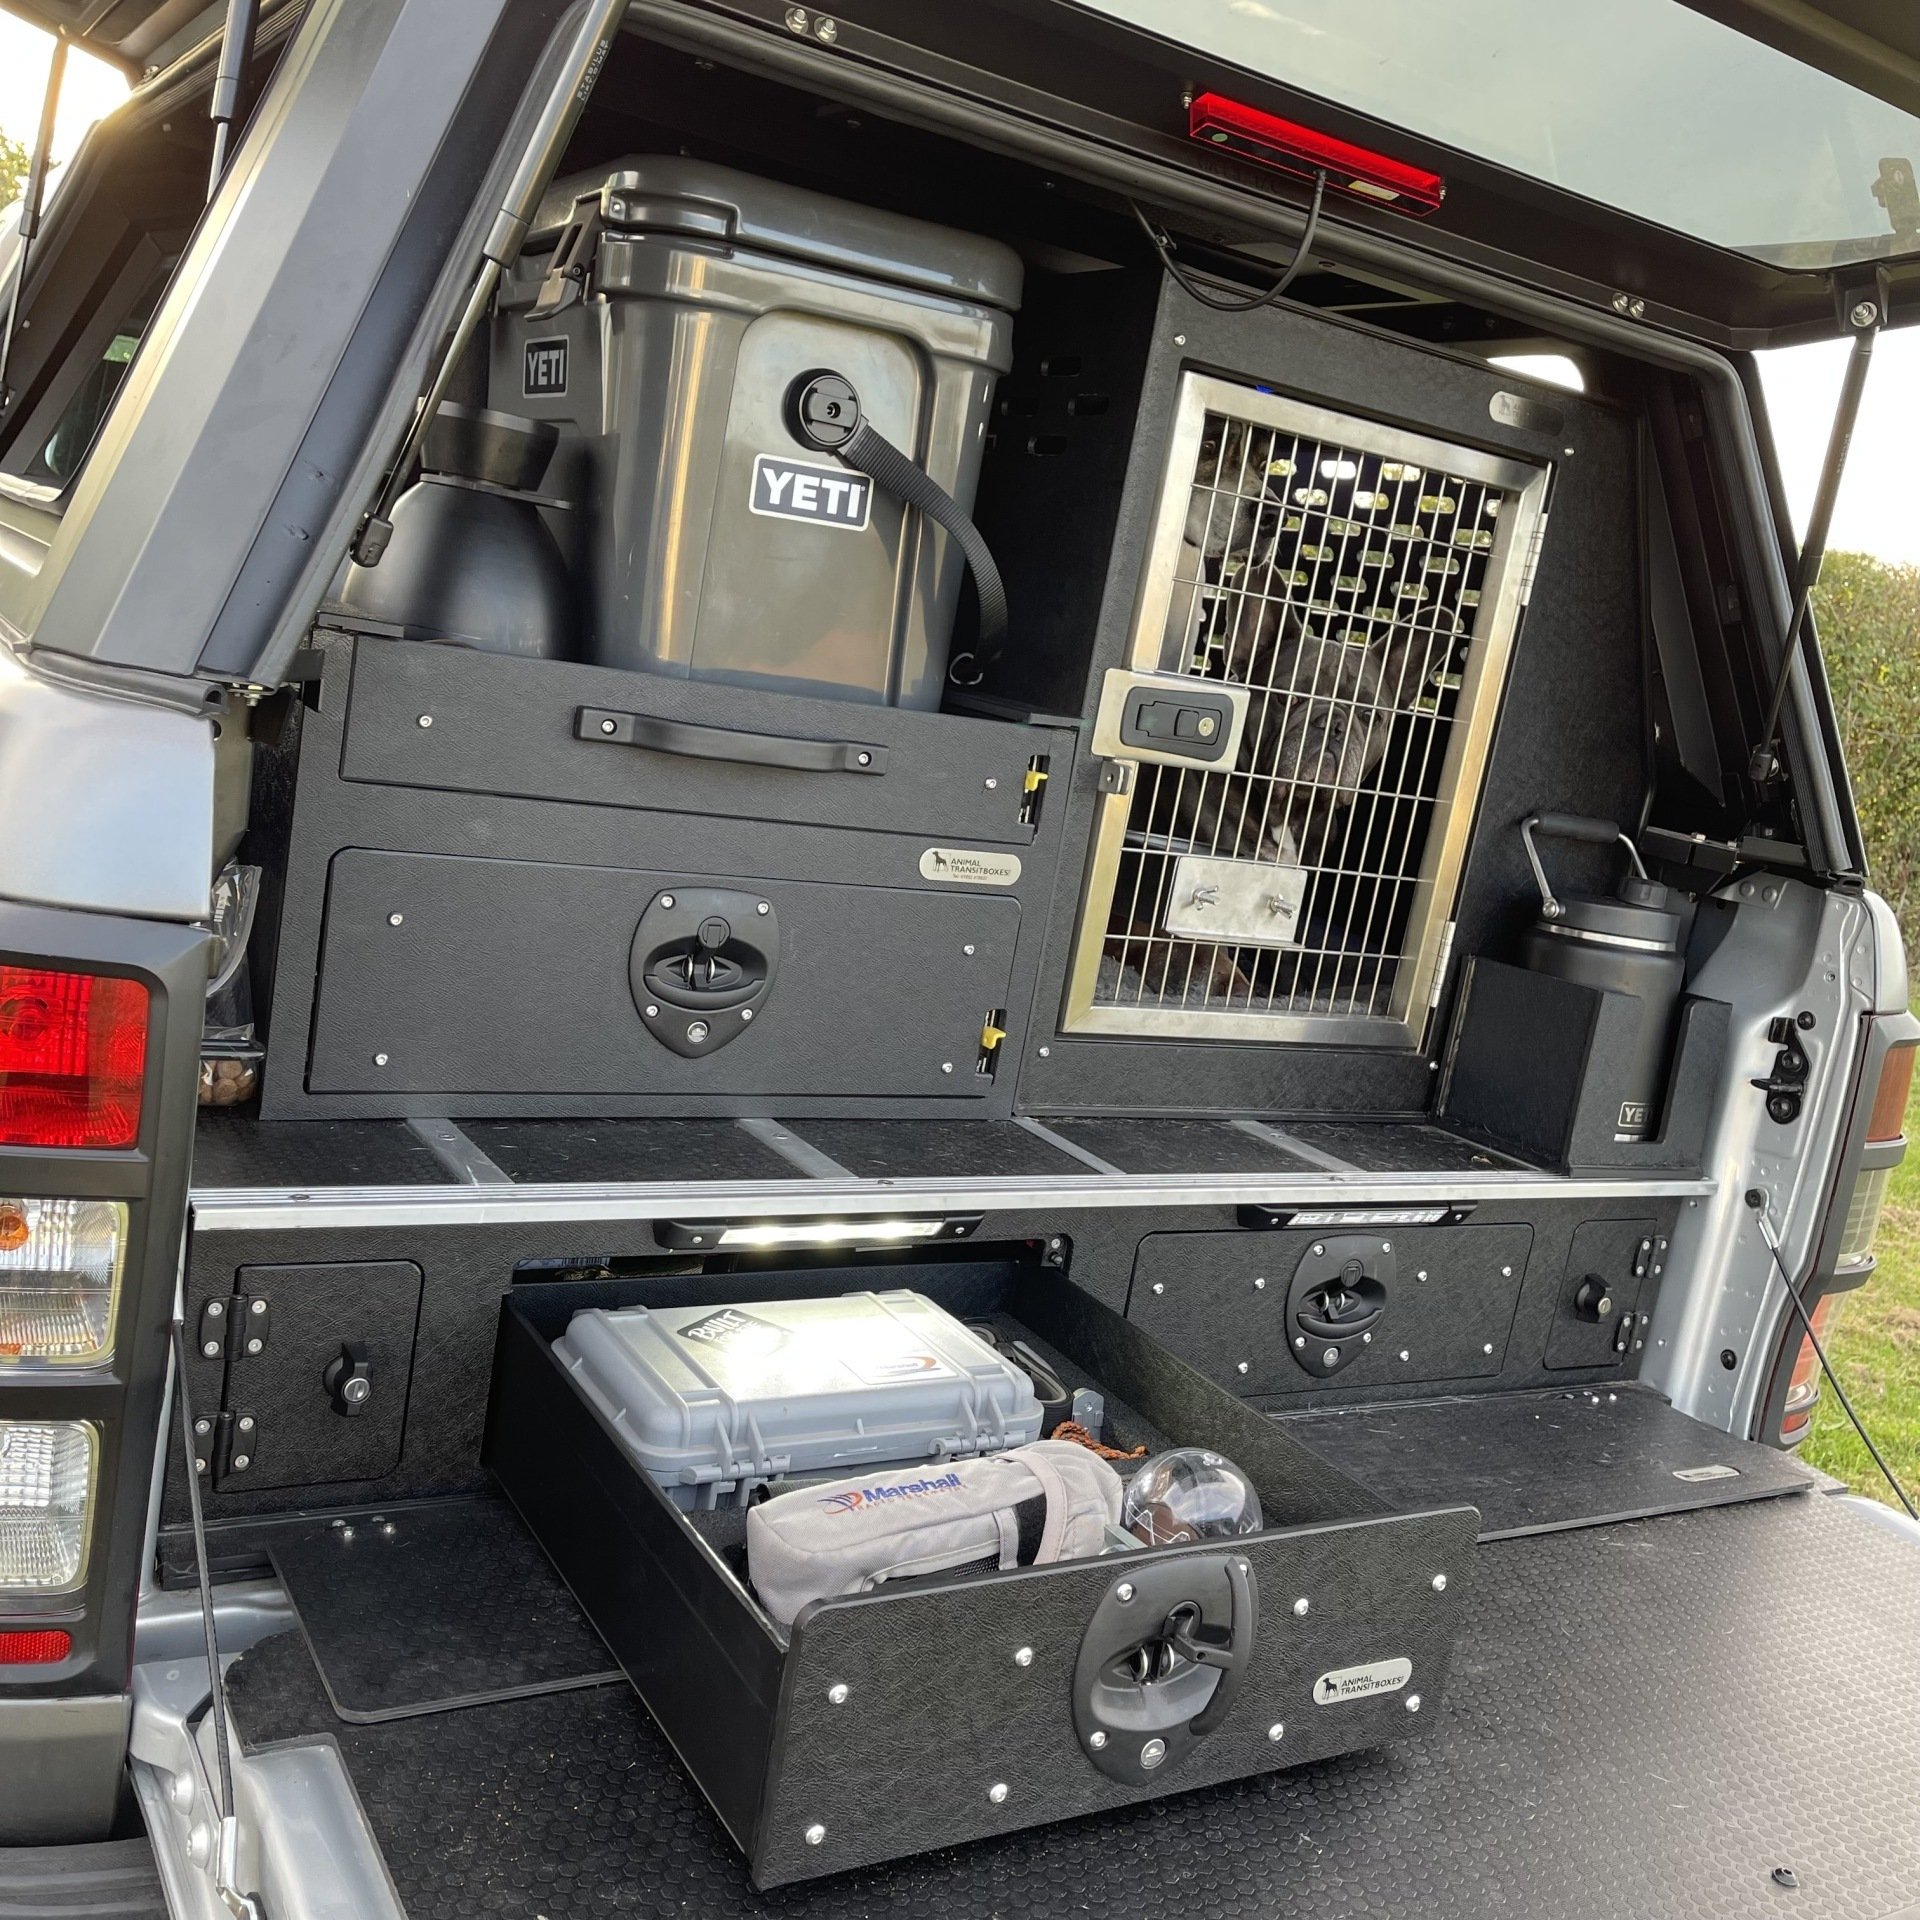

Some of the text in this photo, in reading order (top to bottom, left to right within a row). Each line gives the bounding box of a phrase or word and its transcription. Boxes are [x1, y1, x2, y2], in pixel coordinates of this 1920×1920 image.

[576, 40, 606, 98] STABILUS
[527, 349, 564, 386] YETI
[762, 467, 863, 518] YETI
[950, 858, 981, 866] ANIMAL
[950, 865, 1009, 876] TRANSITBOXES
[1625, 1107, 1649, 1122] YE
[687, 1310, 746, 1342] BUILT
[863, 1473, 962, 1502] Marshall
[1341, 1675, 1374, 1687] ANIMAL
[1341, 1677, 1403, 1696] TRANSITBOXES
